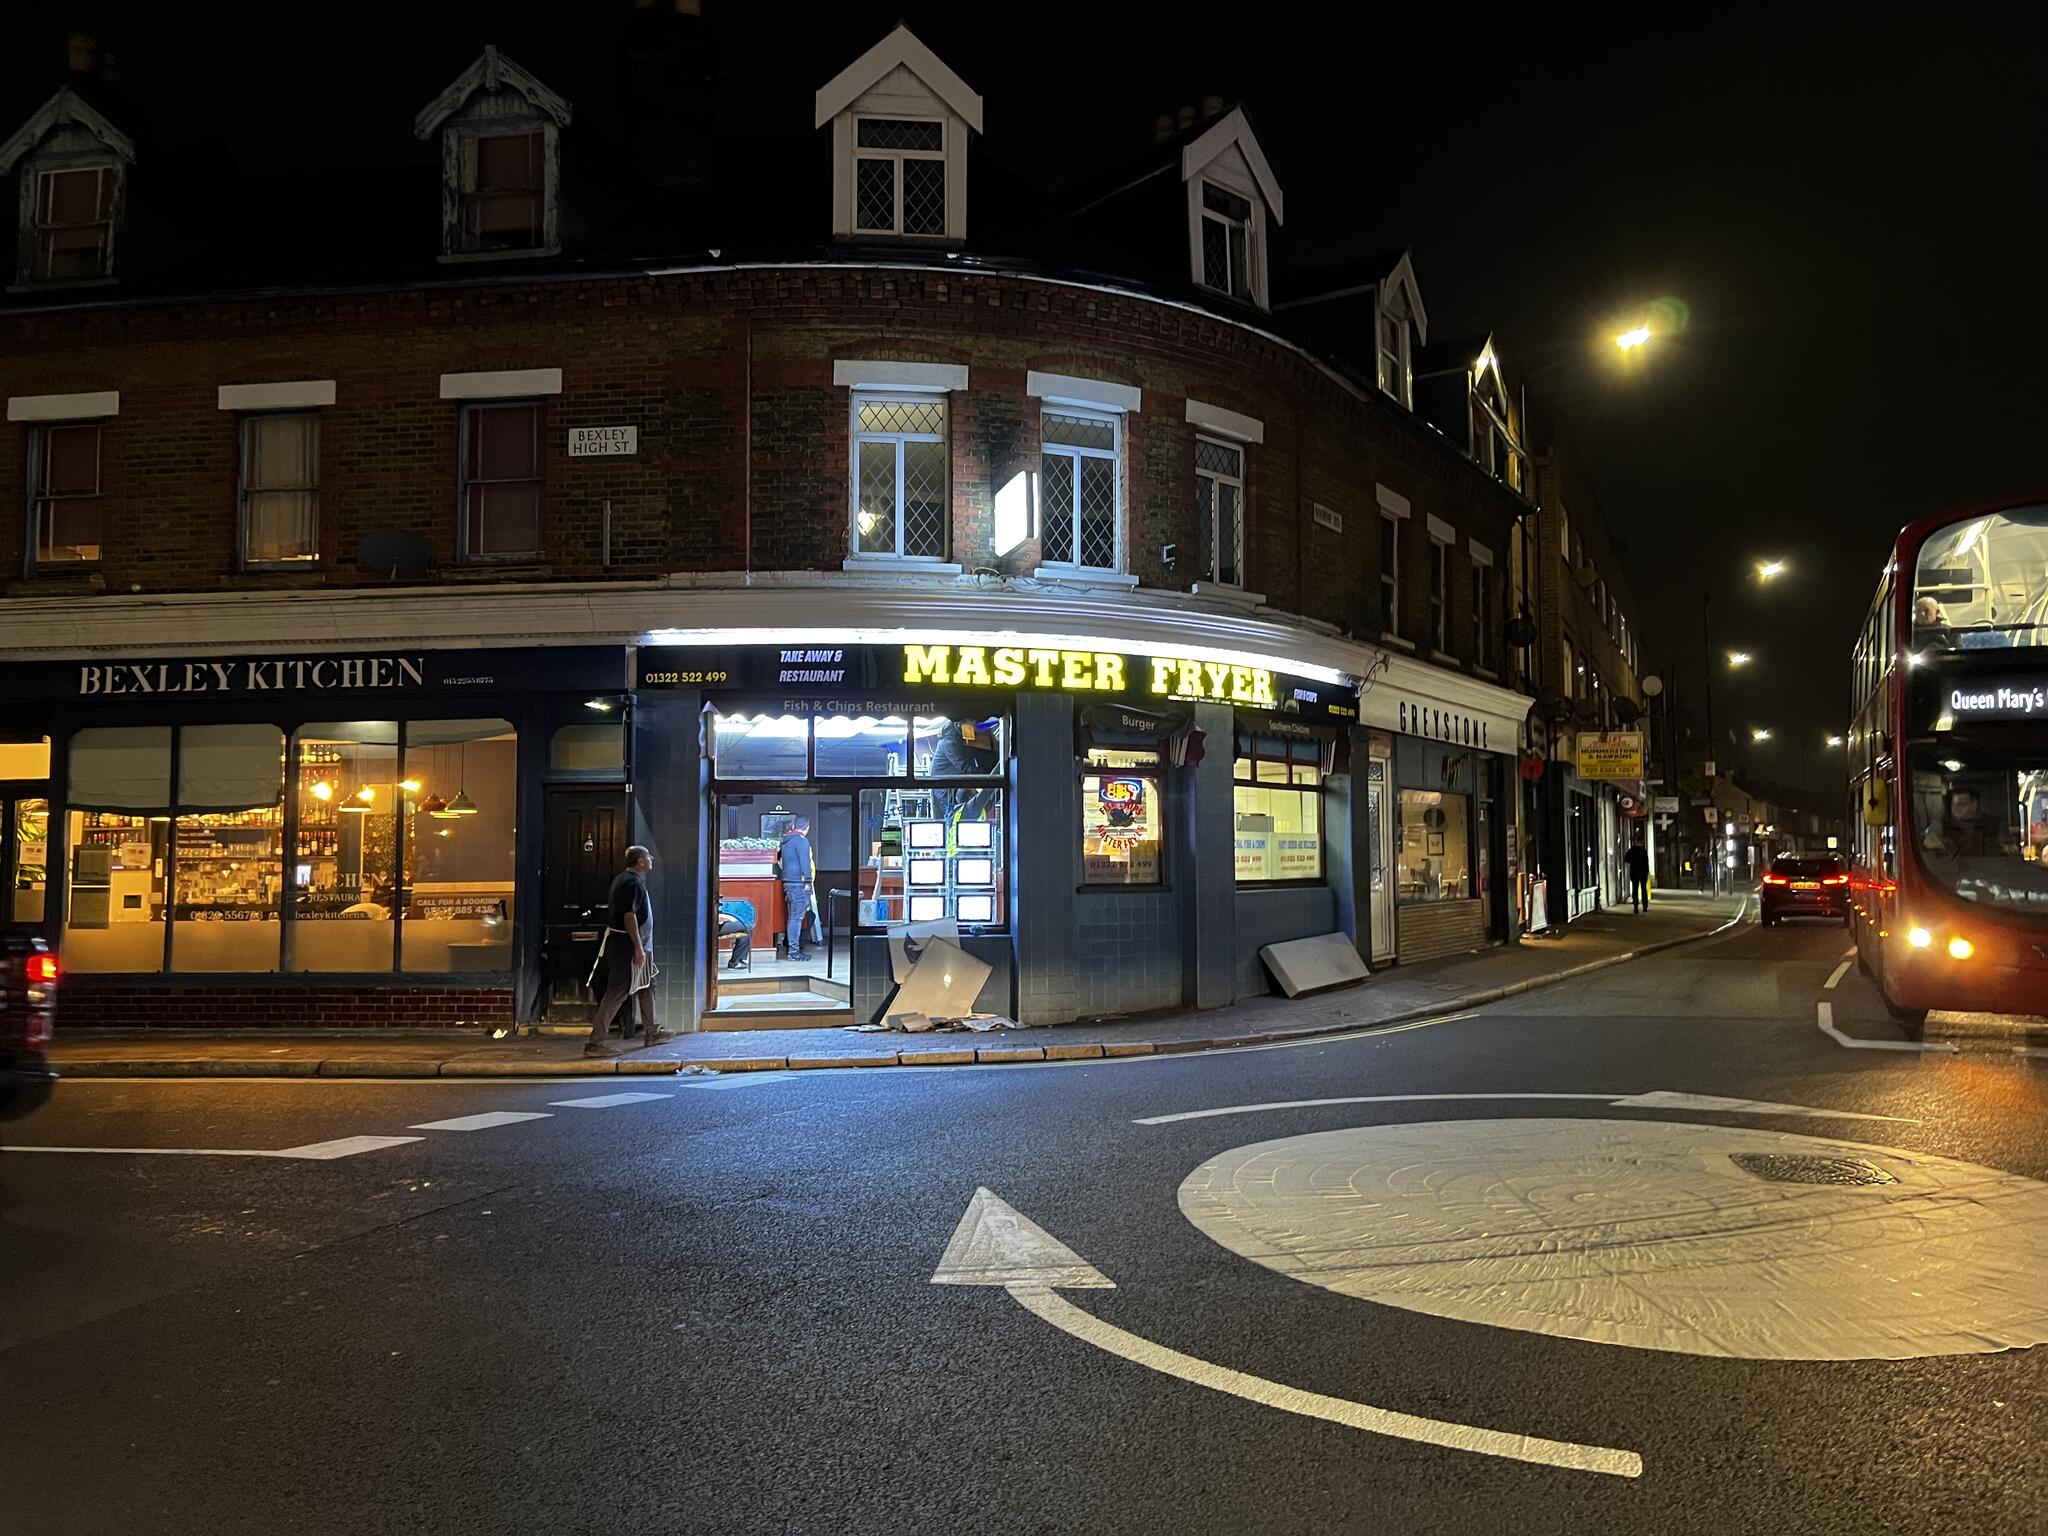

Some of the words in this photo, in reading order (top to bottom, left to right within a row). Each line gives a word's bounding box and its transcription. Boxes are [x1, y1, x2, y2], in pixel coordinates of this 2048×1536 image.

[578, 429, 627, 441] BEXLEY
[573, 442, 608, 453] HIGH
[780, 651, 803, 662] TAKE
[805, 651, 834, 662] AWAY
[834, 650, 843, 661] &
[80, 663, 236, 694] BEXLEY
[246, 658, 424, 690] KITCHEN
[646, 673, 678, 683] 01322
[682, 673, 702, 682] 522
[705, 672, 726, 682] 499
[779, 670, 844, 682] RESTAURANT
[904, 645, 1125, 691] MASTER
[1150, 657, 1274, 703] FRYER
[1951, 690, 1995, 710] Queen
[1998, 688, 2044, 713] Mary's
[783, 701, 809, 712] Fish
[814, 702, 822, 712] &
[827, 701, 862, 715] Chips
[866, 702, 935, 713] Restaurant
[1122, 714, 1156, 730] Burger
[1268, 720, 1292, 732] Southern
[1400, 701, 1487, 749] GREYSTONE
[1107, 783, 1128, 792] FISH
[1097, 825, 1122, 850] MASTER
